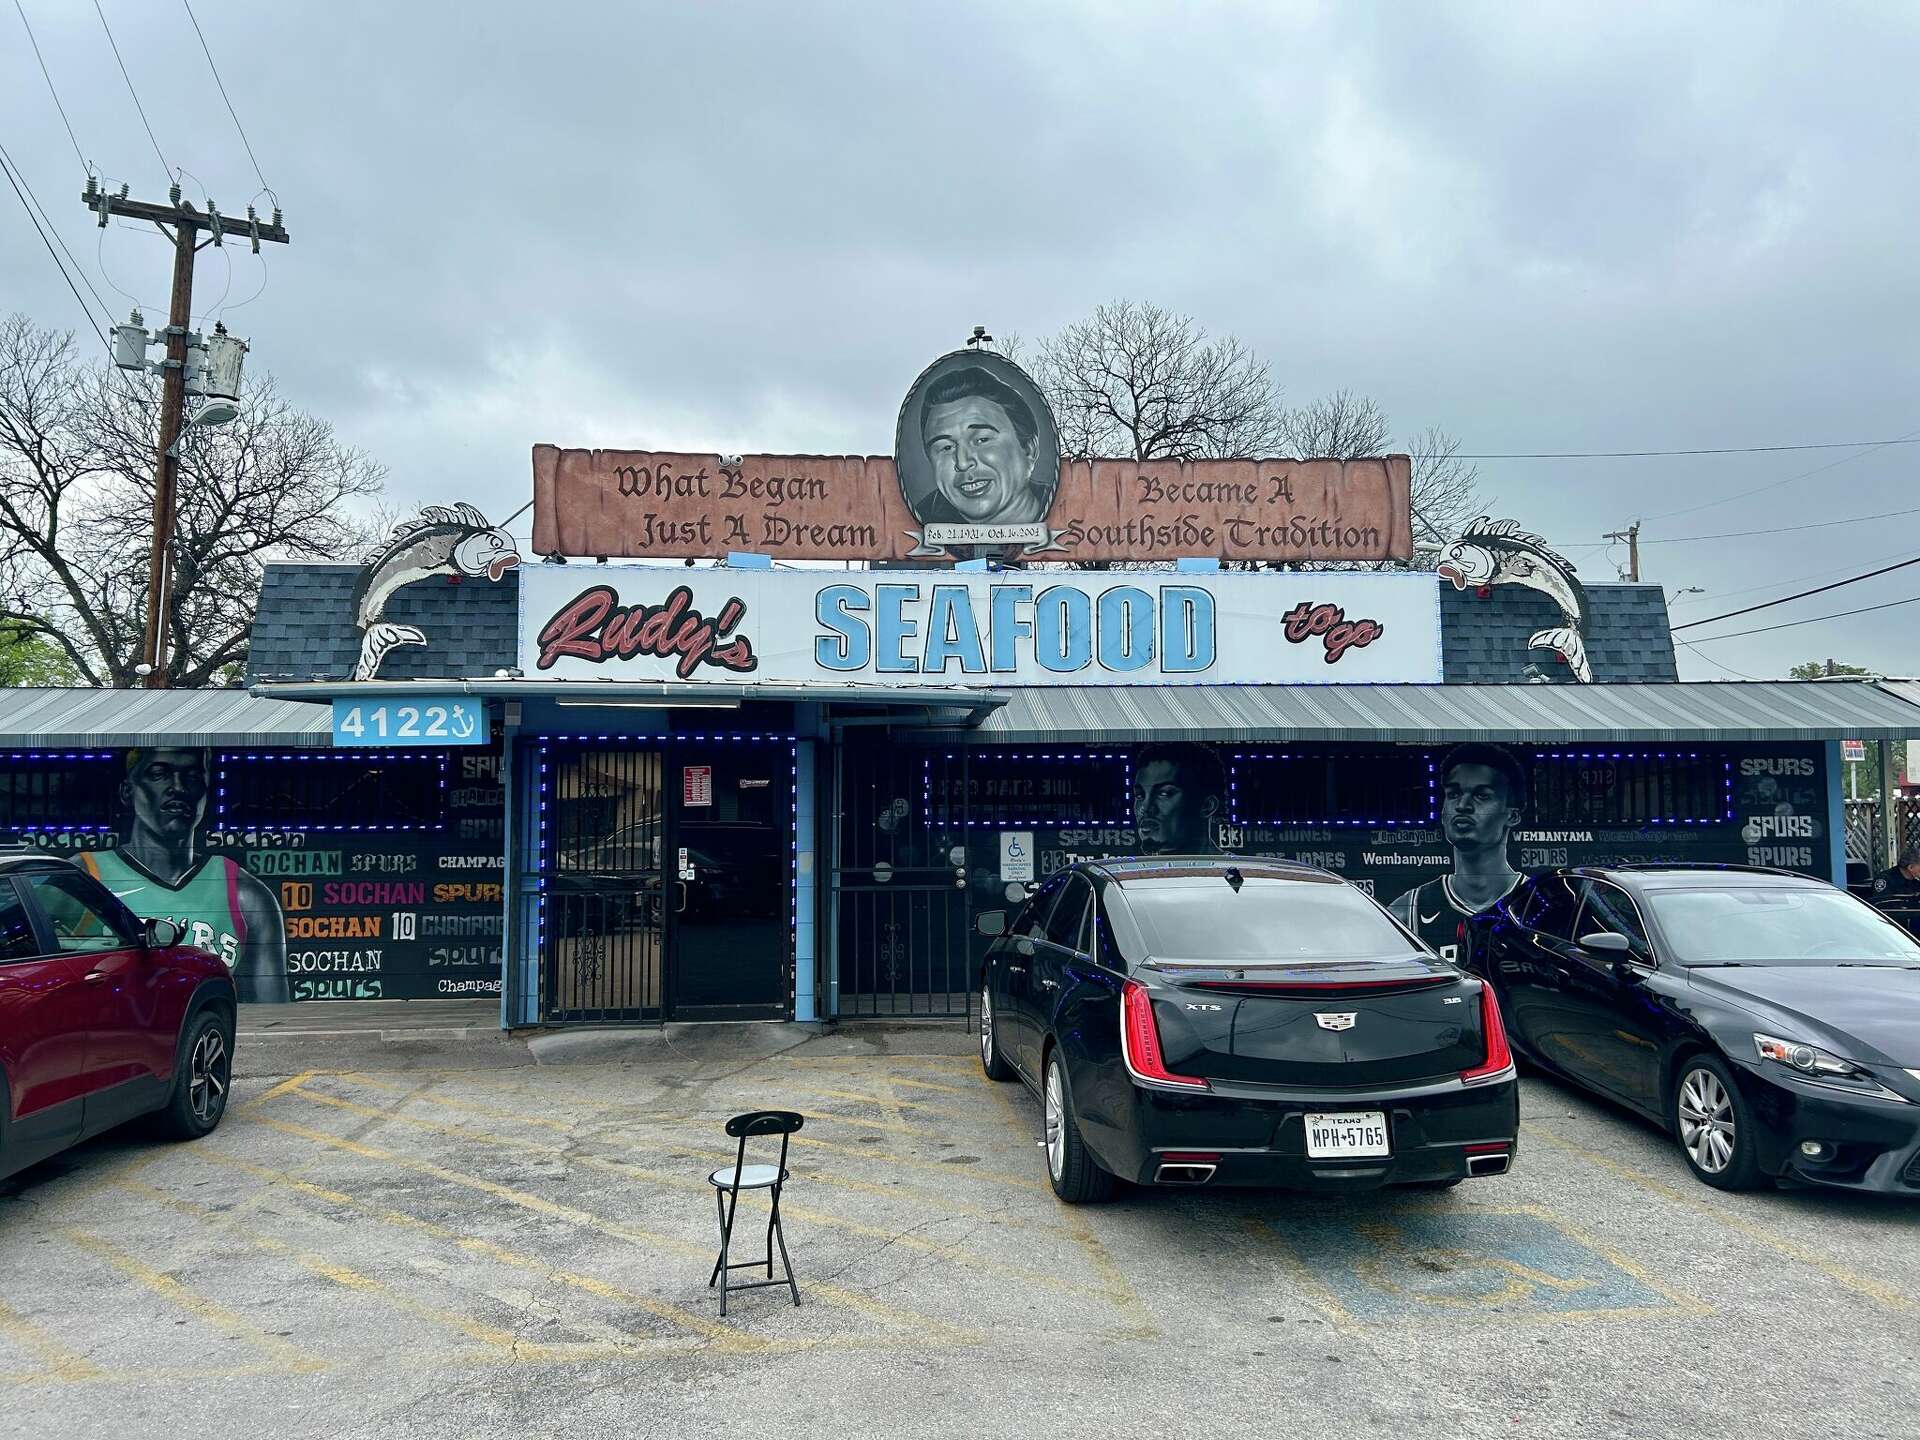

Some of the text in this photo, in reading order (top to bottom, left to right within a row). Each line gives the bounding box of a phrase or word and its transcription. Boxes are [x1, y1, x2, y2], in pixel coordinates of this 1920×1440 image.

[613, 463, 829, 506] What Began
[1137, 475, 1296, 505] Became A
[638, 511, 877, 549] Just A Dream
[1065, 515, 1380, 551] Southside Tradition
[537, 583, 1384, 678] Rudy's SEAFOOD to go
[340, 707, 448, 737] 4122
[1740, 758, 1815, 776] SPURS
[1058, 830, 1136, 846] SPURS
[1512, 831, 1593, 842] WEMBANYAMA
[248, 851, 342, 876] SOCHAN
[351, 853, 417, 873] SPURS
[1363, 853, 1450, 866] Wembanyama
[1521, 849, 1567, 866] SPURS
[1748, 847, 1812, 866] SPURS
[282, 882, 312, 910] 10
[323, 882, 426, 905] SOCHAN
[287, 917, 382, 938] SOCHAN
[392, 912, 416, 941] 10
[288, 950, 382, 973] SOCHAN
[1186, 1003, 1222, 1011] XTS
